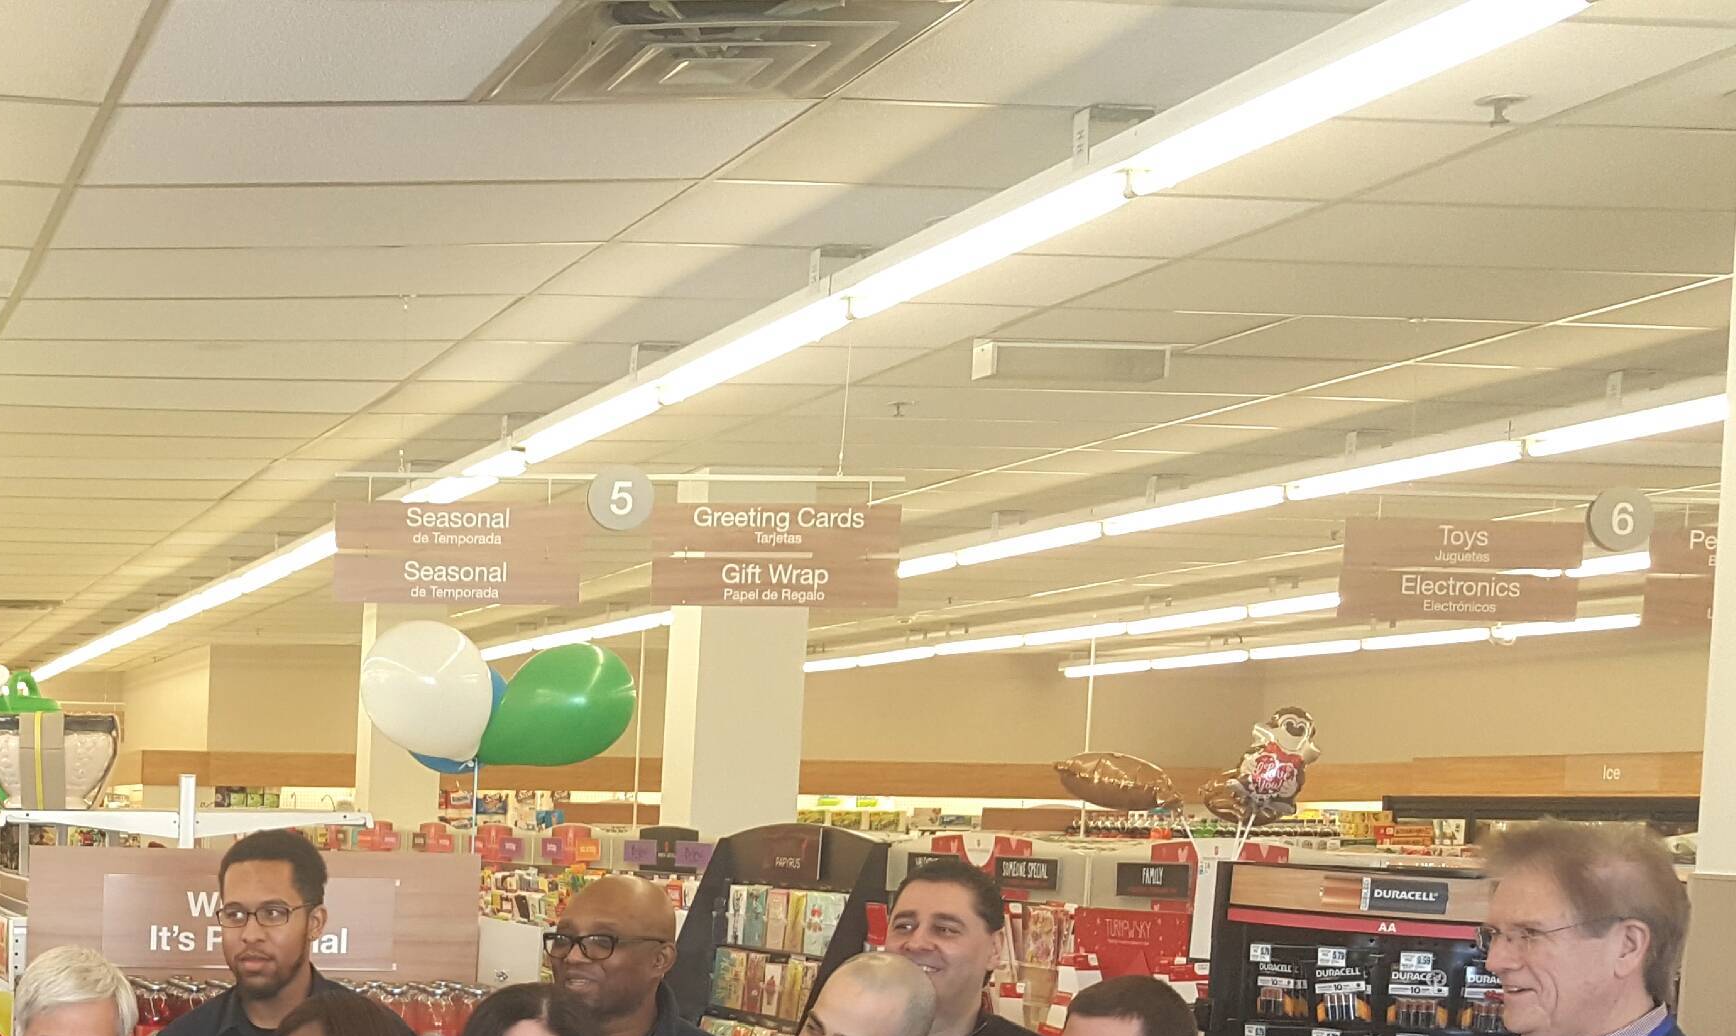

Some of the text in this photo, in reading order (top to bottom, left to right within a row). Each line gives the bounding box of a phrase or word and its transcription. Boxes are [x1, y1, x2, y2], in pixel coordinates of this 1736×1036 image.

[609, 481, 633, 515] 5
[406, 507, 511, 529] Seasonal
[693, 507, 865, 531] Greeting Cards
[1610, 502, 1635, 536] 6
[413, 532, 502, 546] de Temporada
[755, 531, 803, 546] Tarjetas
[1440, 525, 1490, 549] Toys
[1689, 529, 1718, 550] Pe
[1434, 550, 1491, 564] Juguetes
[404, 560, 507, 582] Seasonal
[721, 563, 830, 592] Gift Wrap
[410, 586, 500, 600] de Temporada
[723, 588, 826, 604] Papel de Regalo
[1401, 575, 1521, 598] Electronics
[1602, 764, 1622, 781] Ice
[1142, 866, 1164, 886] FAMILY
[186, 890, 223, 918] W
[1373, 888, 1437, 902] DURACELL
[1377, 921, 1397, 933] AA
[150, 924, 196, 952] It's
[1259, 962, 1293, 973] DURACELL
[1315, 967, 1361, 978] DURACELL
[1410, 986, 1421, 994] 10
